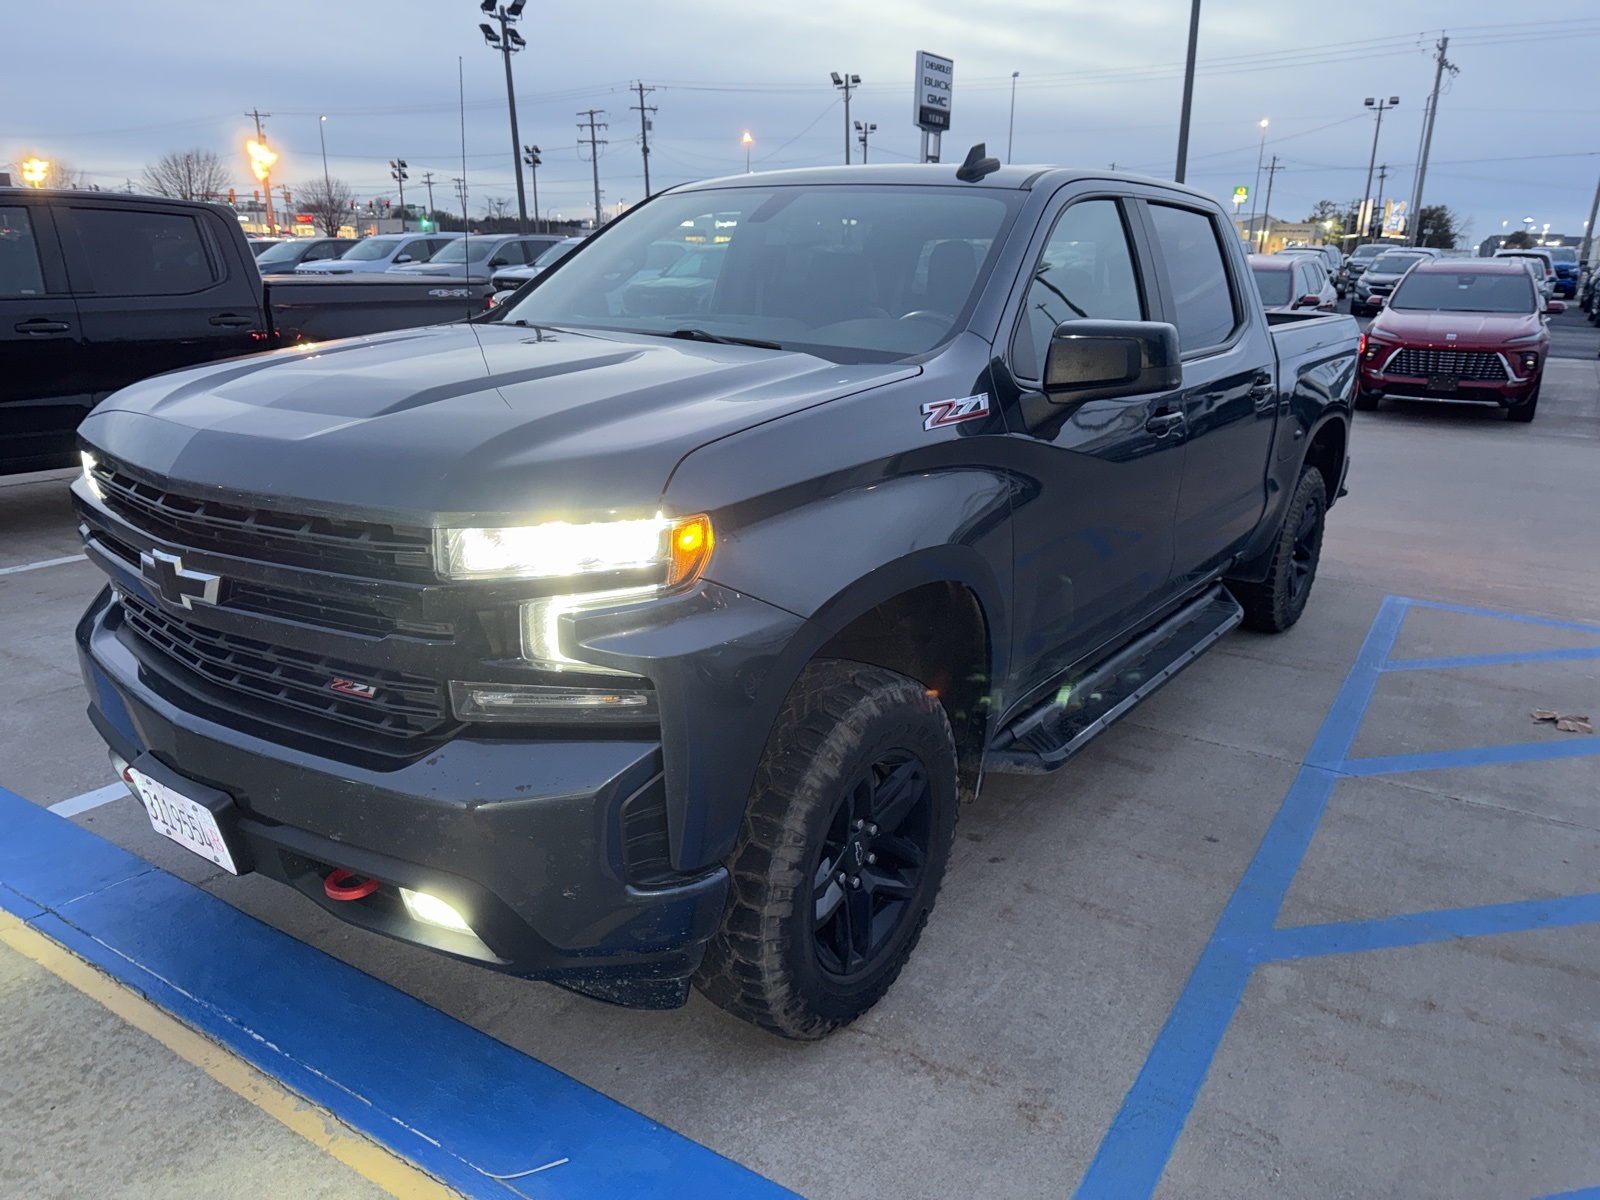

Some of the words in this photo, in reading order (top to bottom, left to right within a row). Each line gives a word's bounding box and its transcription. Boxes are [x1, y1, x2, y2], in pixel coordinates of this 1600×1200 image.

[925, 60, 952, 74] CHEVROLET
[924, 76, 951, 91] BUICK
[927, 93, 947, 107] GMC
[921, 392, 989, 431] Z71
[330, 677, 377, 699] Z71
